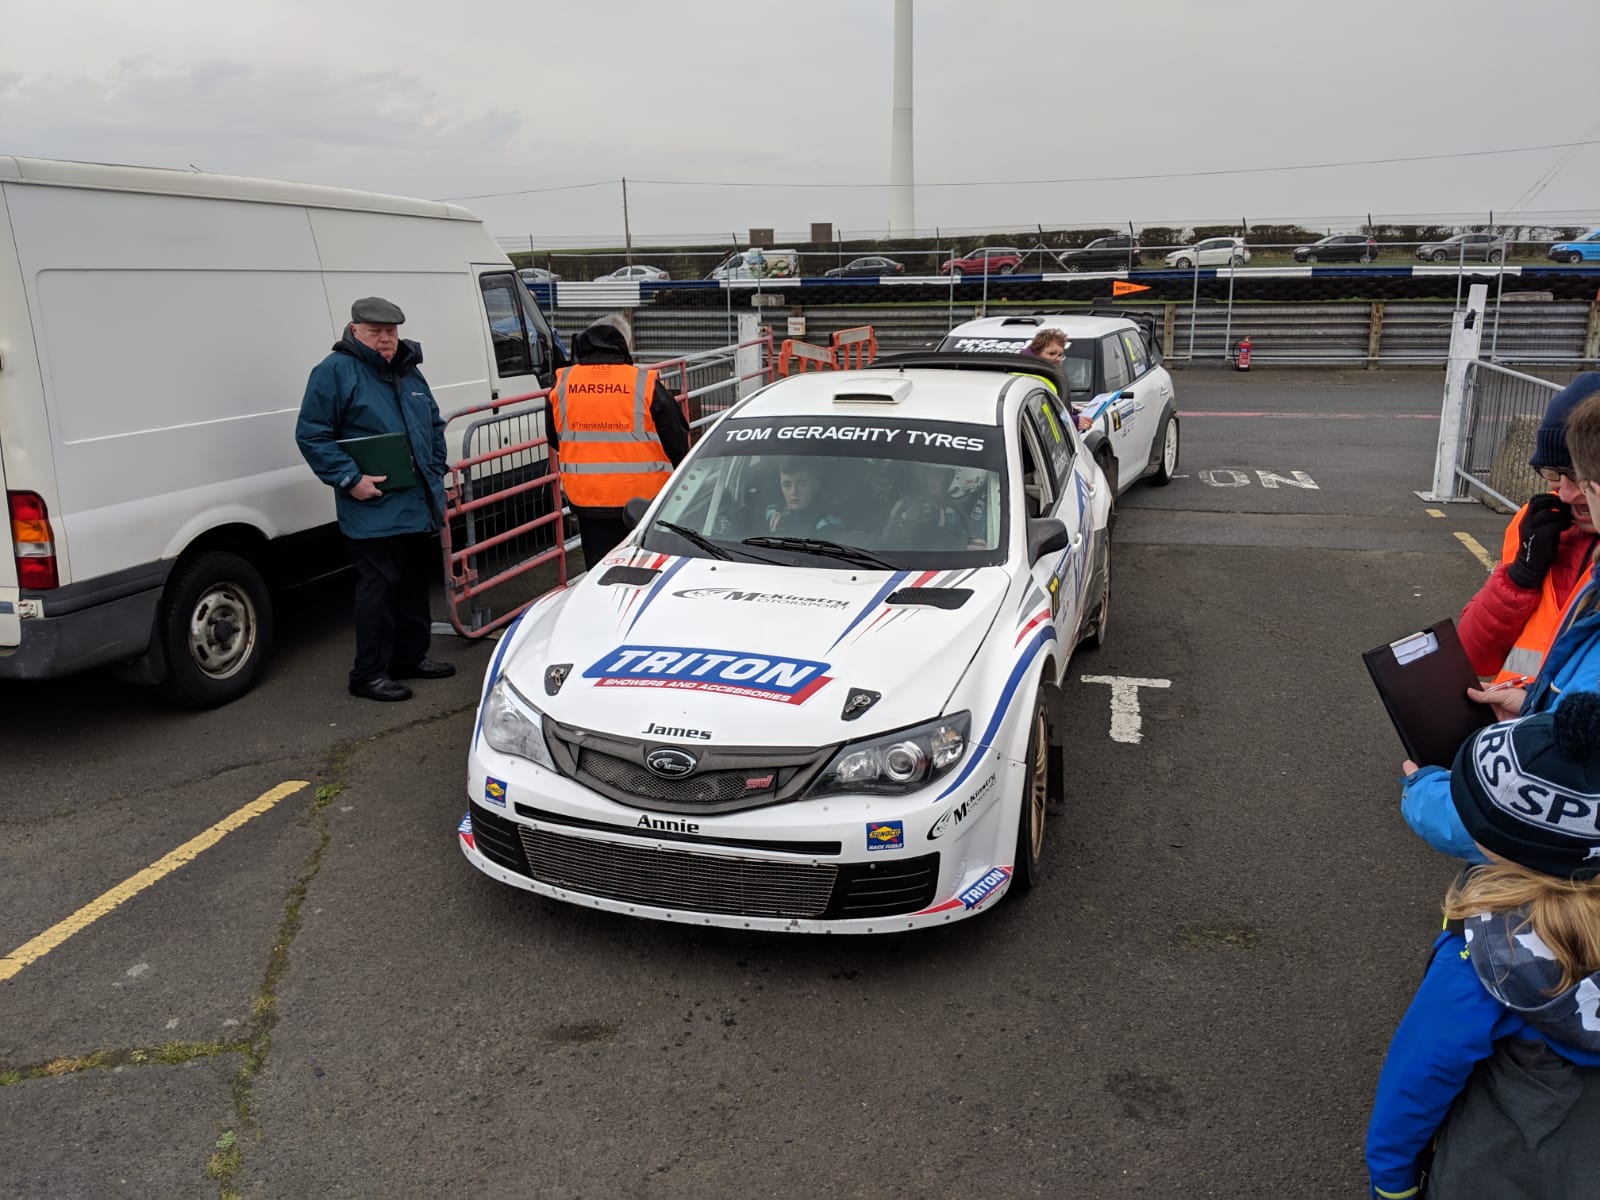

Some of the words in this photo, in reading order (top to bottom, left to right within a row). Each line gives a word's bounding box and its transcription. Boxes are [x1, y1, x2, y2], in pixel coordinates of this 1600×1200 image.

[568, 383, 631, 394] MARSHAL
[725, 427, 773, 442] TOM
[776, 425, 901, 443] GERAGHTY
[906, 429, 985, 452] TYRES
[723, 590, 851, 606] McKinstry
[605, 649, 817, 688] TRITON
[602, 678, 665, 687] SHOWERS
[669, 681, 696, 689] AND
[697, 683, 793, 702] ACCESSORIES
[641, 722, 713, 740] James
[636, 814, 700, 834] Annie
[869, 828, 901, 839] SUNOCO
[961, 869, 1006, 905] TRITON
